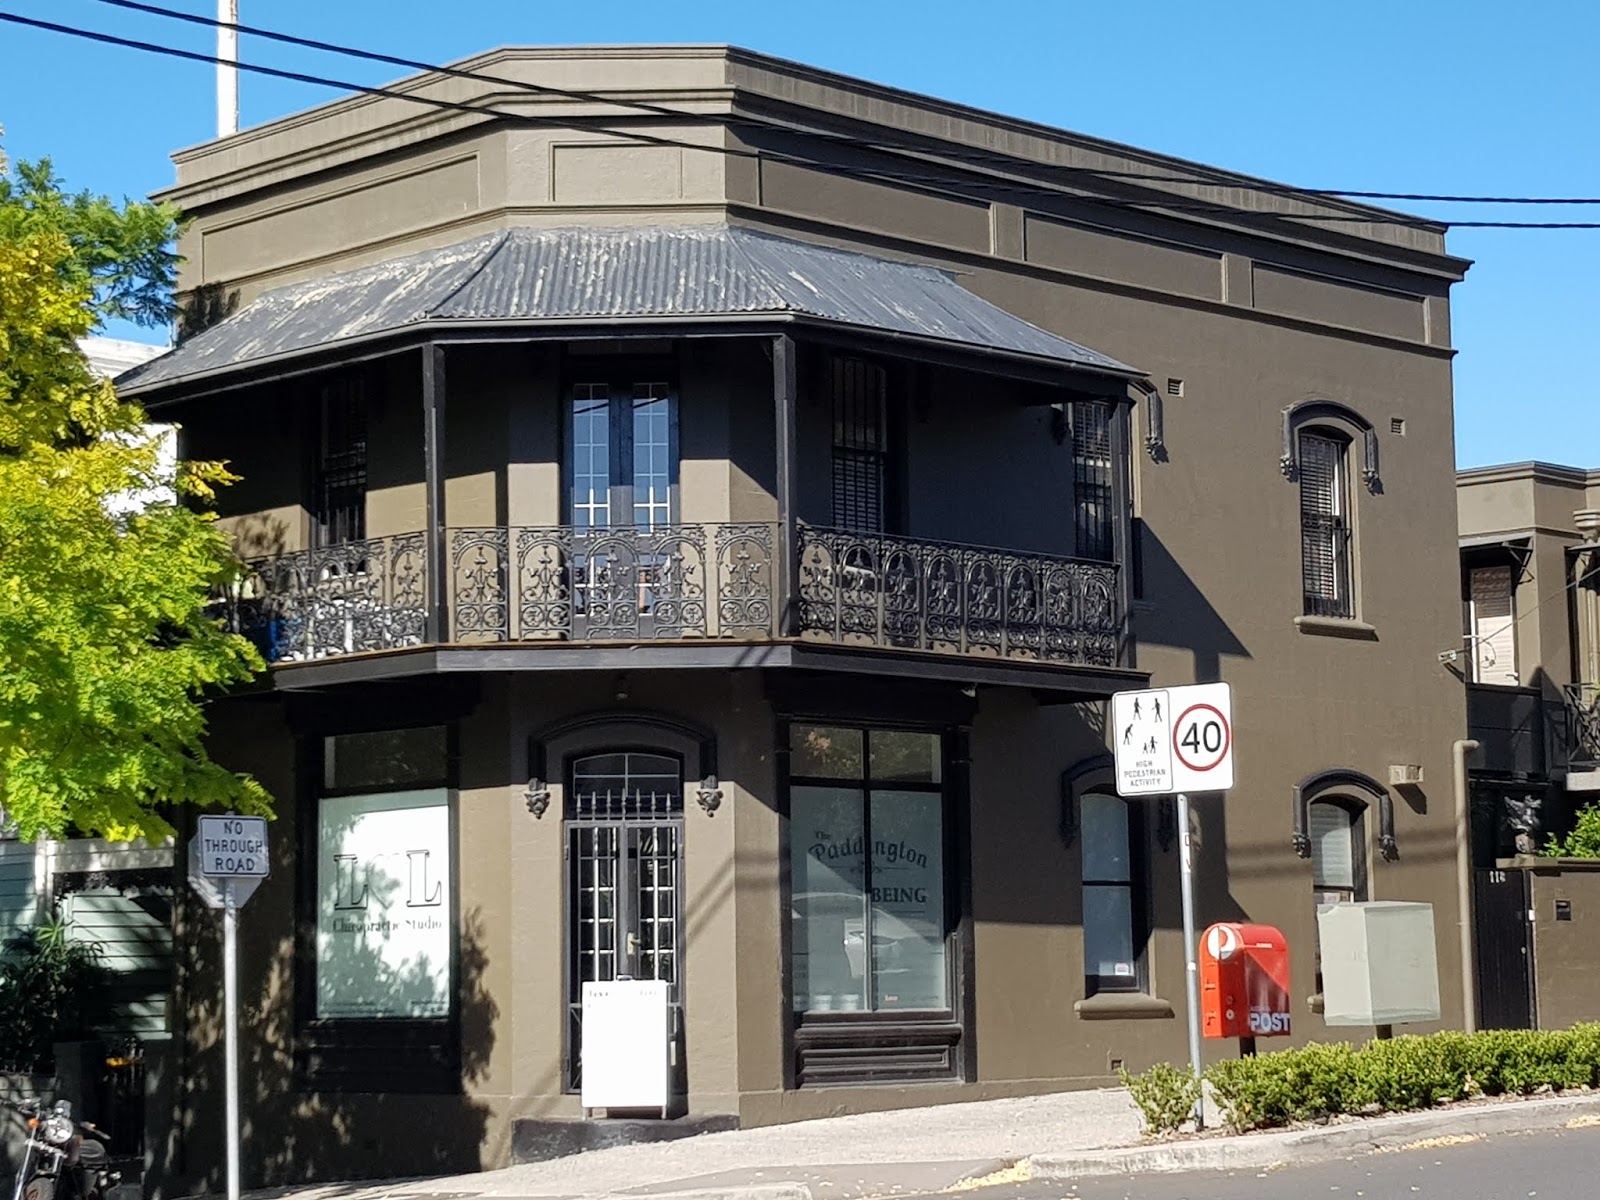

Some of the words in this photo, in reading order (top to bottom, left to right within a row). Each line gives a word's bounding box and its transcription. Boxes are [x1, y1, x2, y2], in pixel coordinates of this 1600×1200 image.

[1181, 721, 1221, 753] 40
[1136, 760, 1152, 768] HIGH
[1124, 769, 1166, 778] PEDESTRIAN
[1130, 778, 1161, 787] ACTIVITY
[224, 821, 243, 835] NO
[205, 839, 263, 853] THROUGH
[808, 836, 928, 868] Paddngton
[215, 857, 255, 872] ROAD
[871, 887, 928, 903] BEING
[1250, 1012, 1290, 1032] POST
